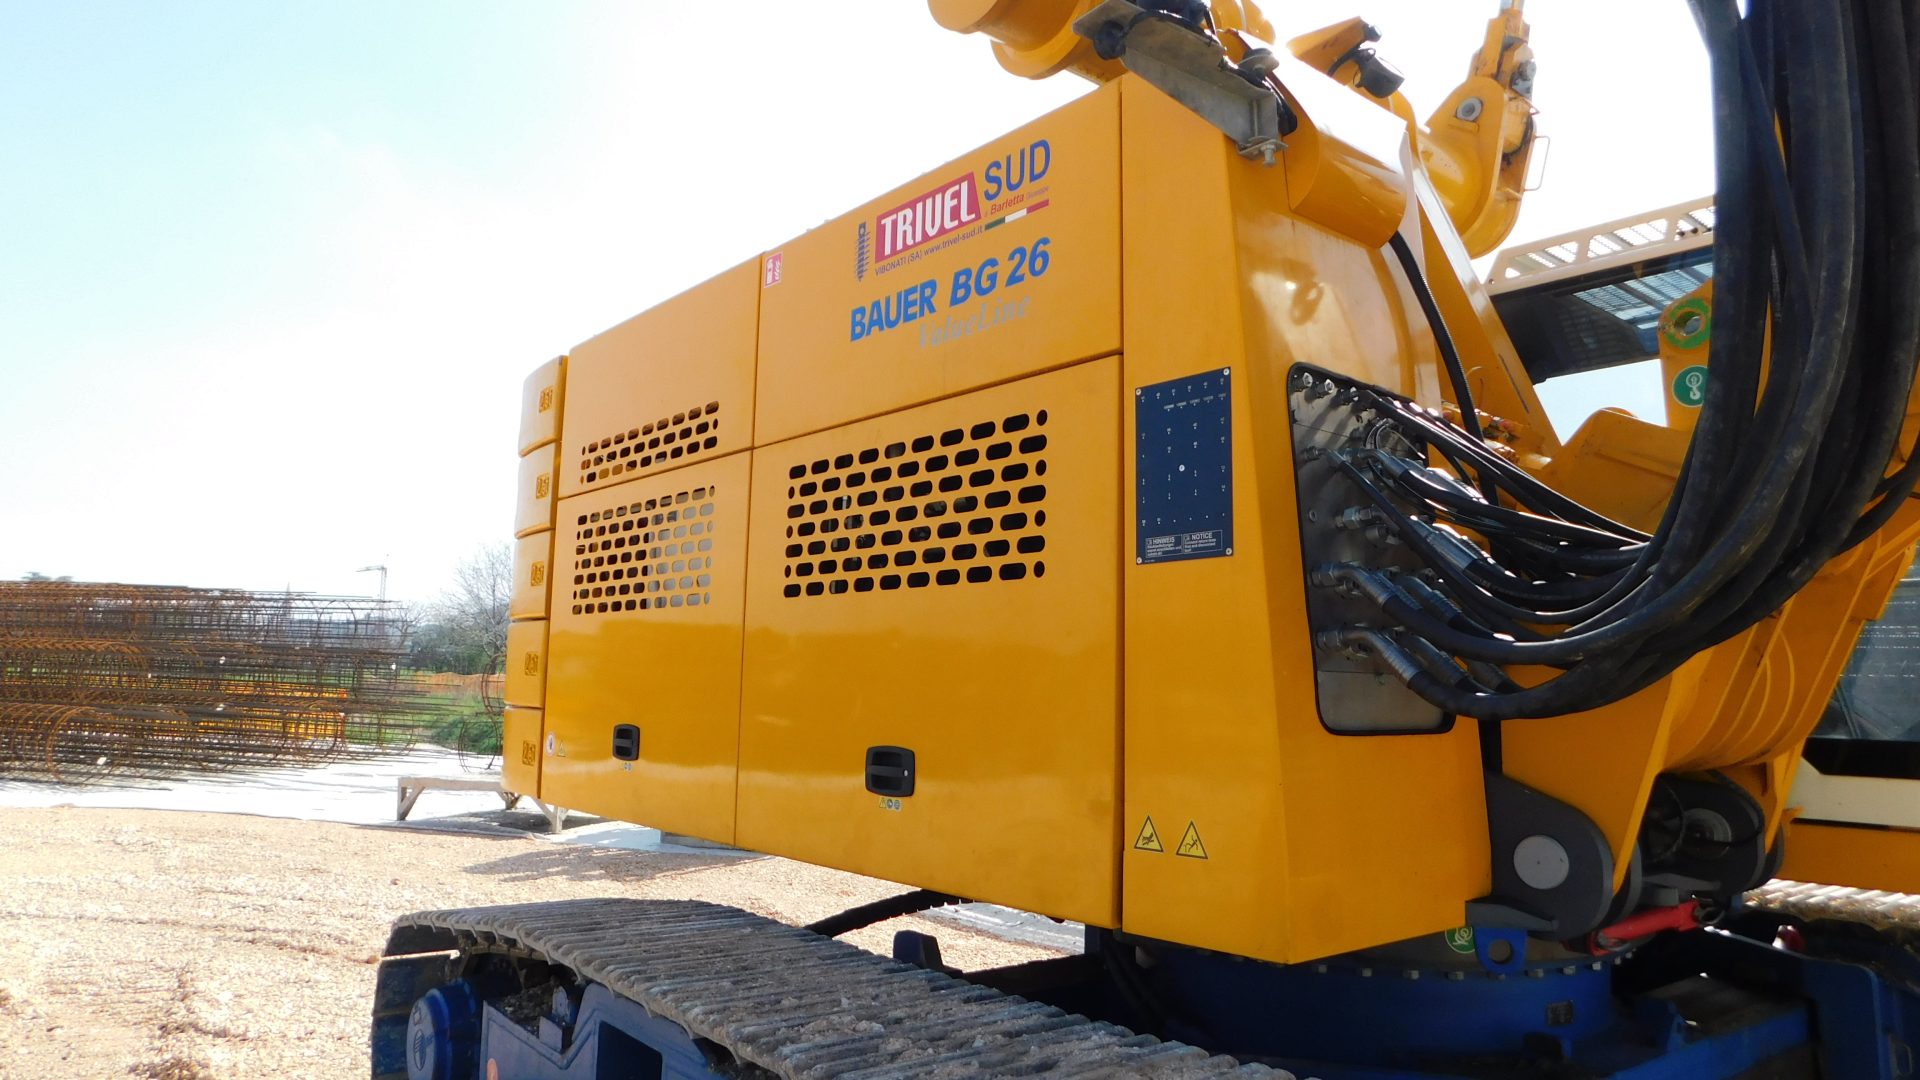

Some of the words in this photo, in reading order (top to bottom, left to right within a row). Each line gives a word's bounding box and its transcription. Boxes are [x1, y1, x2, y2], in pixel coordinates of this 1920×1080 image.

[880, 180, 976, 256] TRIVEL
[983, 139, 1051, 202] SUD
[990, 194, 1025, 216] Barletta
[850, 278, 938, 342] BAUER
[949, 257, 999, 308] BG
[1005, 236, 1051, 288] 26
[874, 258, 907, 277] VIBONATI
[923, 225, 983, 257] www.trivel-sud.it
